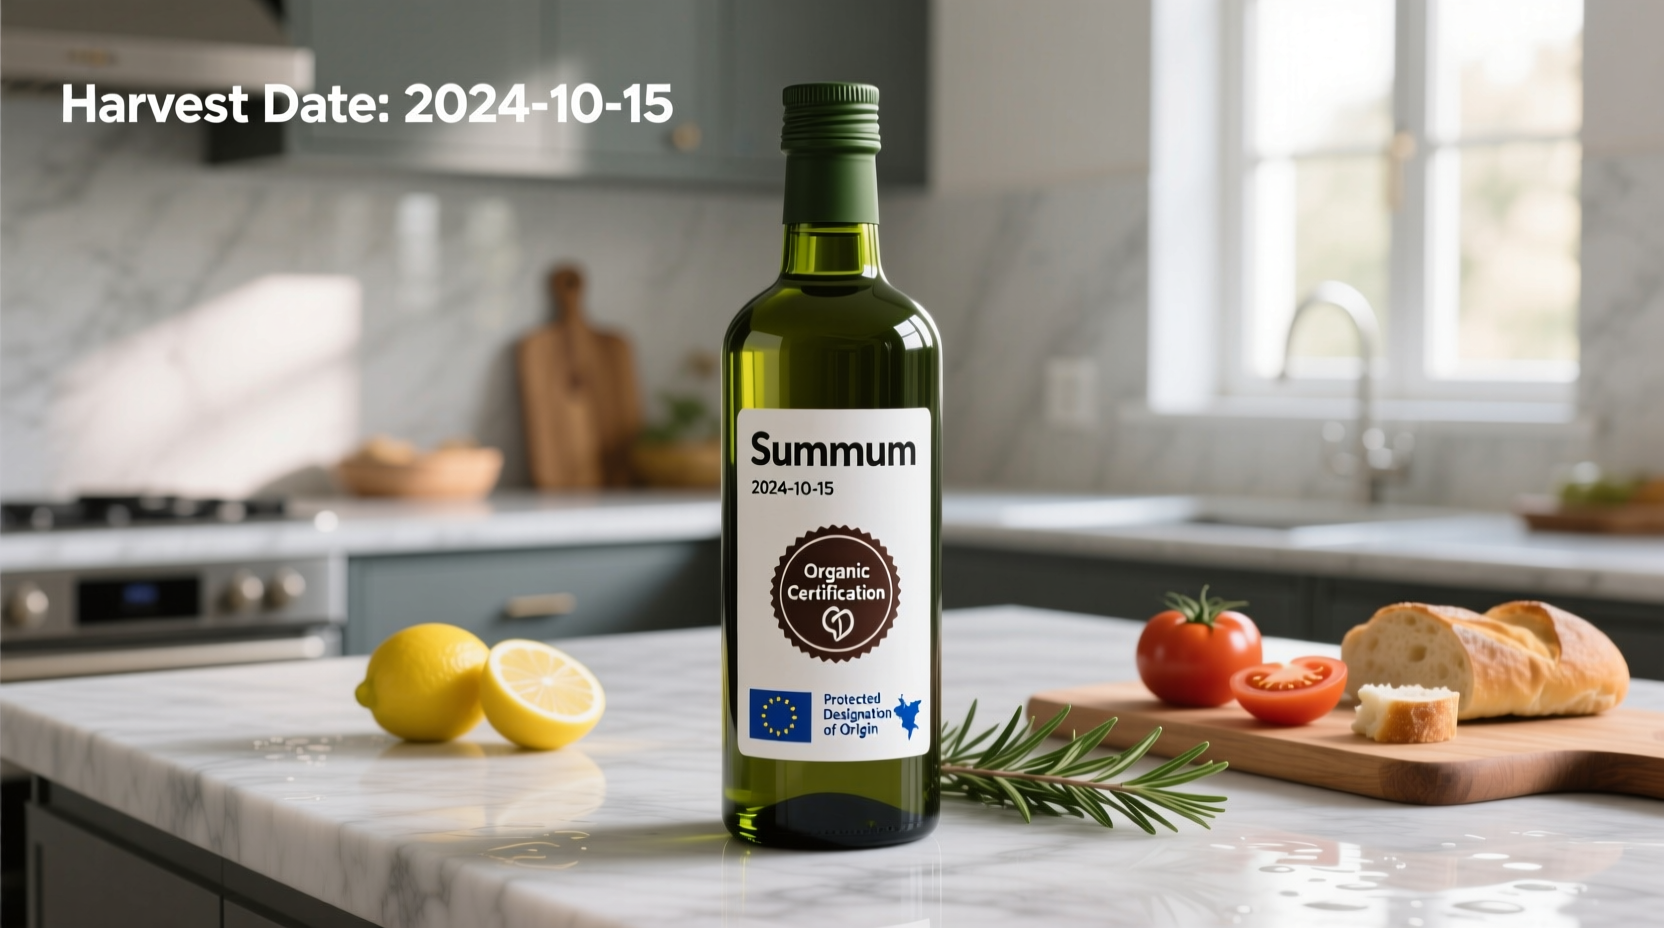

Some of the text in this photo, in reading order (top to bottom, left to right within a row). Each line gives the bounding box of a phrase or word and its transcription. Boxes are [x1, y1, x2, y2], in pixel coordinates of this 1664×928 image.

[751, 430, 916, 467] Summum
[751, 479, 835, 496] 2024-10-15
[804, 562, 870, 583] Organic
[787, 584, 886, 601] Certification
[823, 692, 881, 705] Protected
[823, 707, 892, 723] Designation
[823, 723, 837, 736] of
